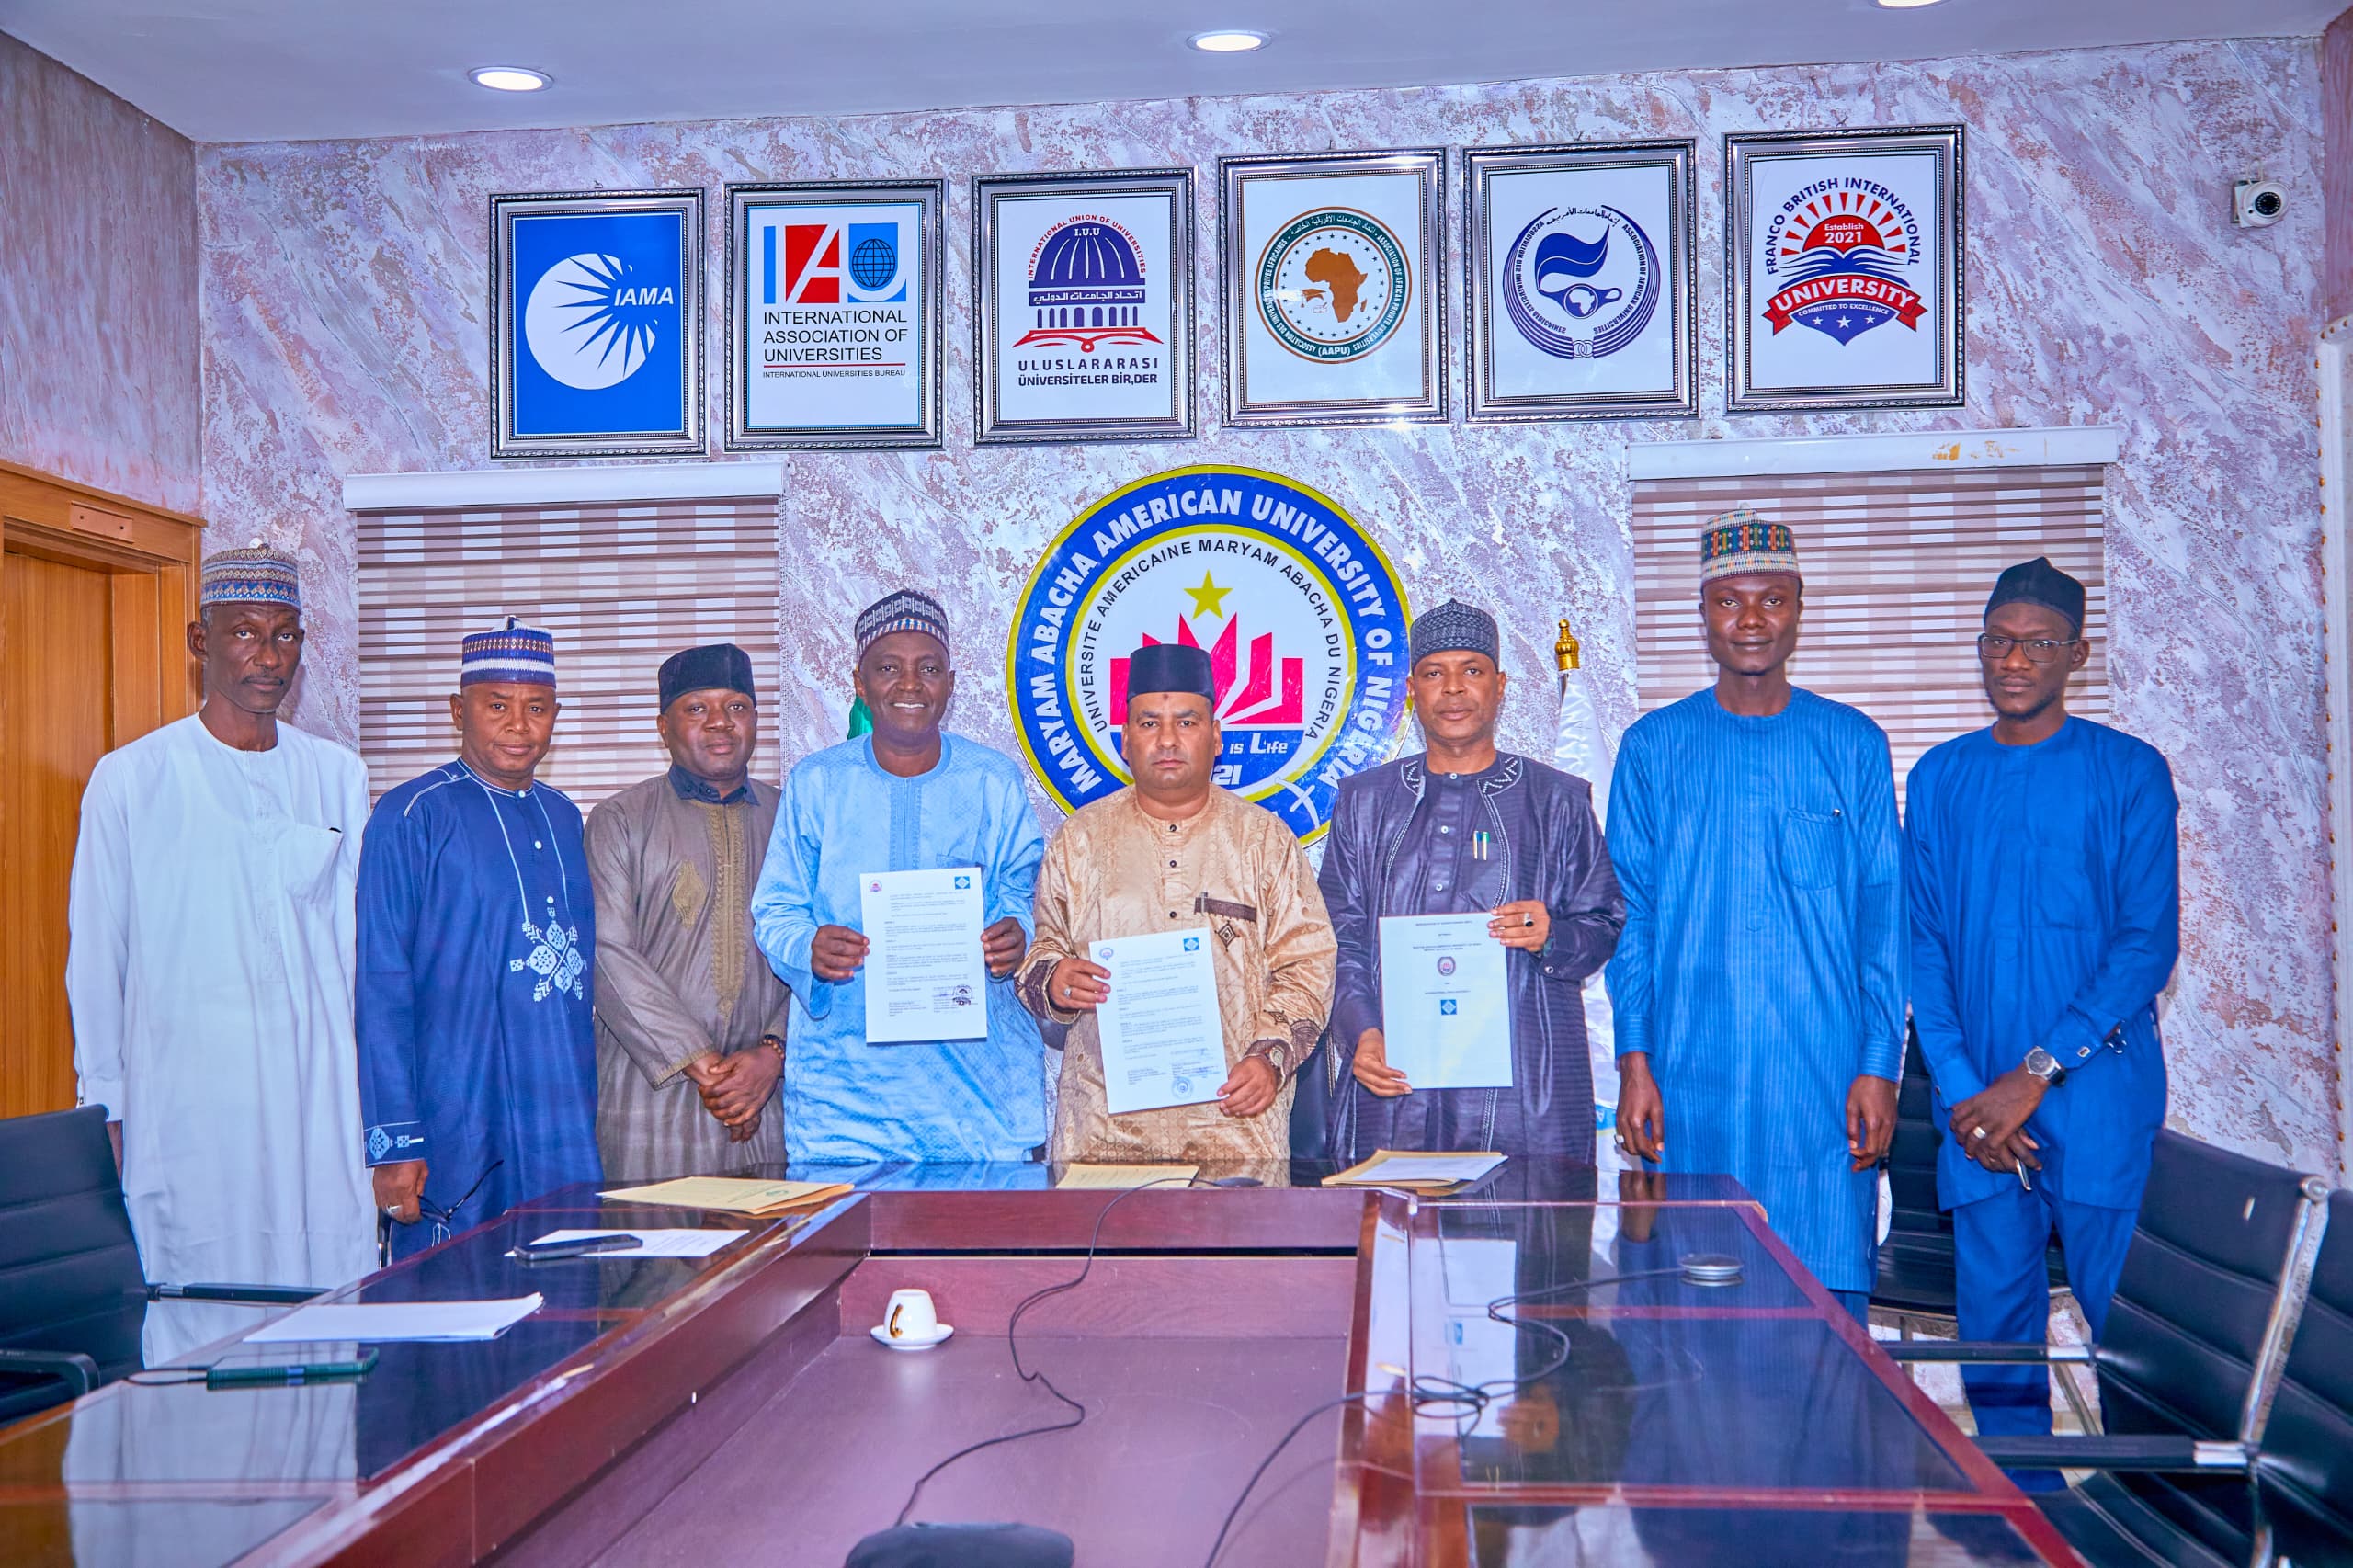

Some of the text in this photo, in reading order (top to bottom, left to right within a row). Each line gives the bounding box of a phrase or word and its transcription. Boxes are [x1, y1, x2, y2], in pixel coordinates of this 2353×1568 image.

[1765, 177, 1921, 275] FRANCO BRITISH INTERNATIONAL
[1028, 214, 1146, 278] INTERNATIONAL UNION OF UNIVERSITIES
[1824, 232, 1862, 244] 2021
[614, 287, 674, 306] IAMA
[1774, 278, 1915, 312] UNIVERSITY
[764, 310, 907, 324] INTERNATIONAL
[1798, 303, 1837, 316] COMMITTED
[1849, 303, 1890, 315] EXCELLENCE
[764, 328, 908, 344] ASSOCIATION OF
[764, 347, 882, 362] UNIVERSITIES
[1018, 358, 1158, 371] ULUSLARARASI
[1030, 488, 1393, 794] MARYAM ABACHA AMERICAN UNIVERSITY OF NIGERIA
[1081, 540, 1342, 740] UNIVERSITE AMERICAINE MARYAM ABACHA DU NIGERIA
